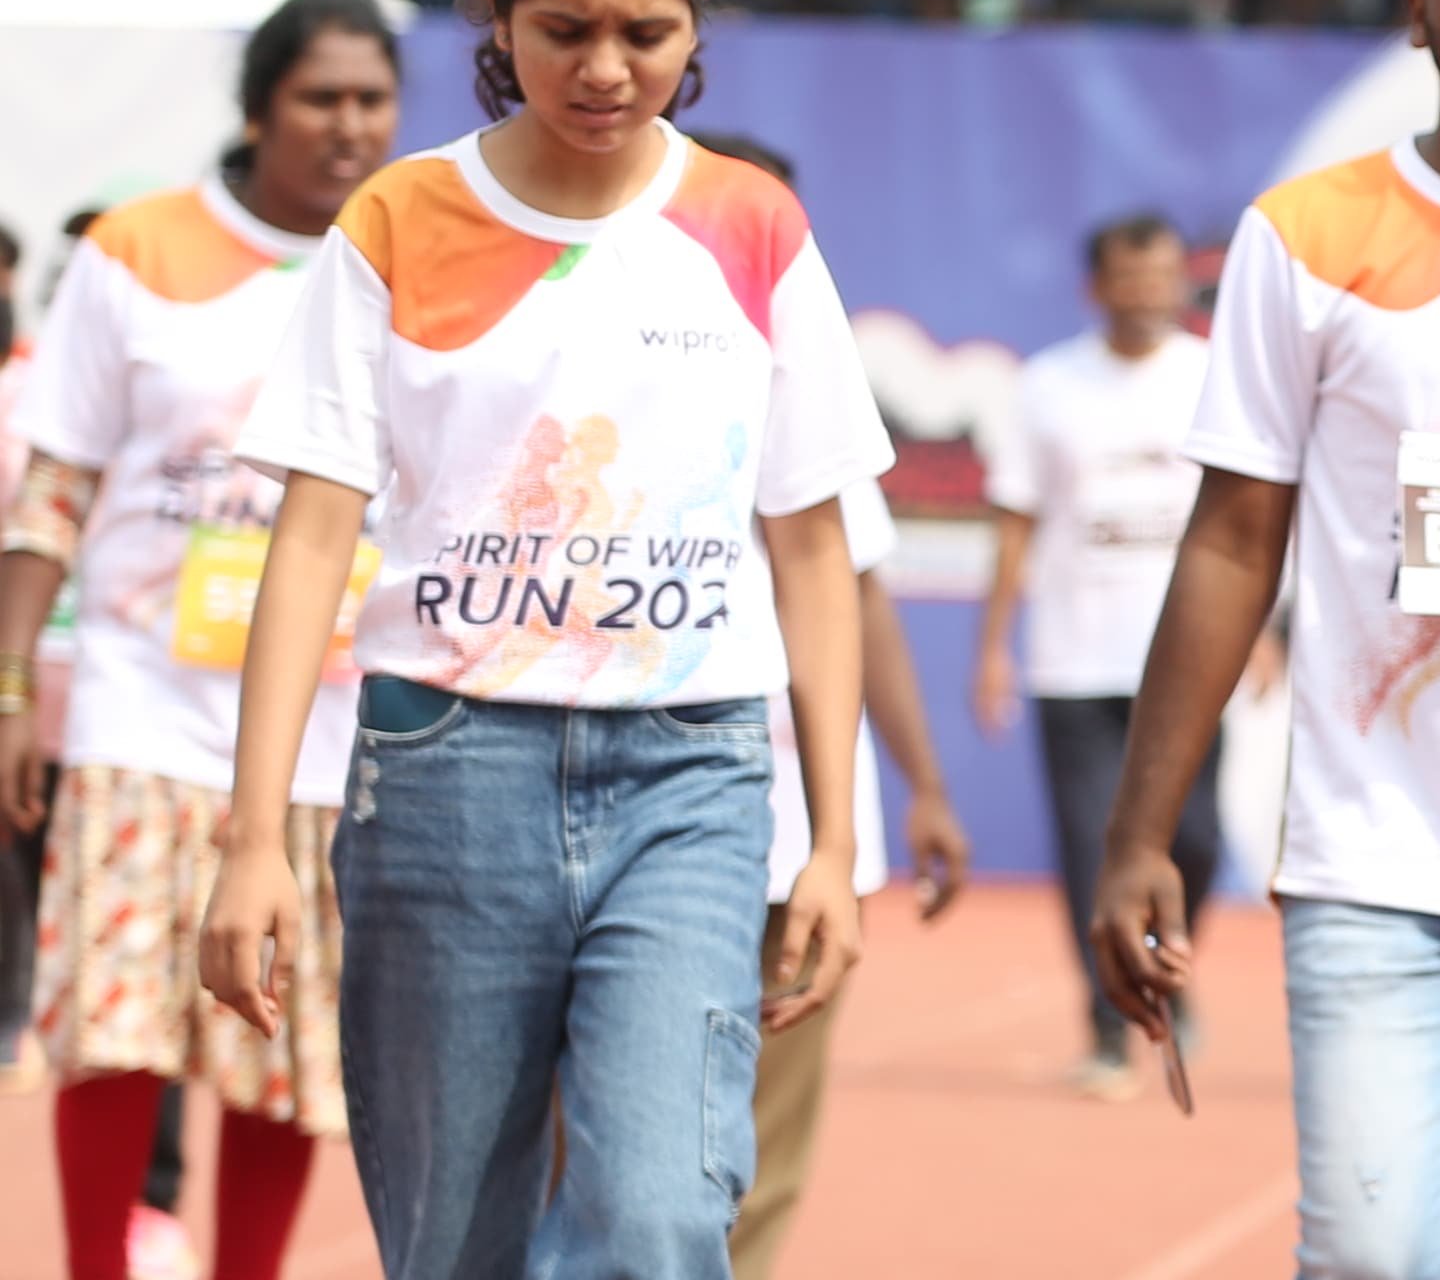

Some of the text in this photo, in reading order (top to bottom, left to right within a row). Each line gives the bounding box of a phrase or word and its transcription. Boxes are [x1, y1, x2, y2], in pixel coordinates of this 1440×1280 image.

[640, 327, 729, 355] wipro
[565, 535, 630, 566] OF
[416, 573, 574, 628] RUN
